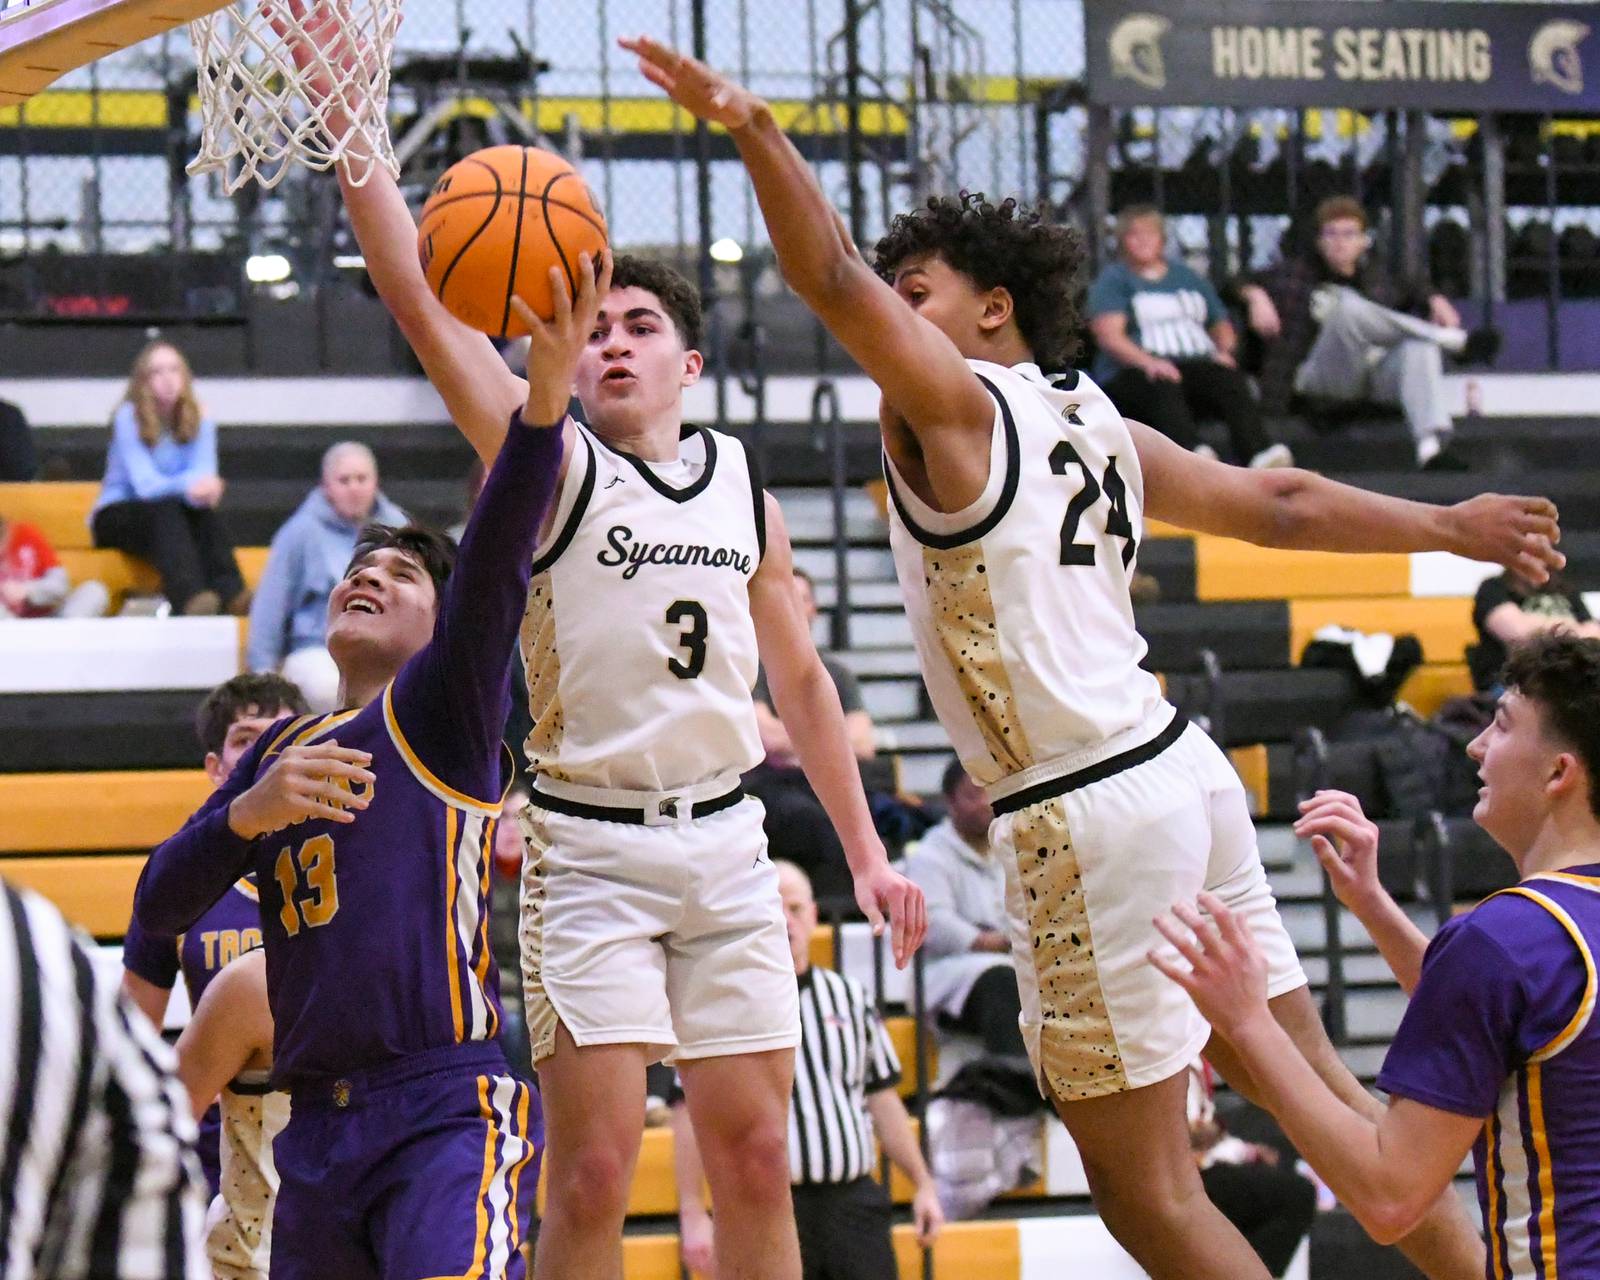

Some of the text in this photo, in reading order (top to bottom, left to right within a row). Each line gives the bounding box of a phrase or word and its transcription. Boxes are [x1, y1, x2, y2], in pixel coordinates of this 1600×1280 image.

[1210, 26, 1492, 83] HOME SEATING
[1048, 440, 1136, 572] 24
[596, 525, 751, 580] Sycamore
[665, 600, 709, 680] 3
[274, 832, 340, 938] 13
